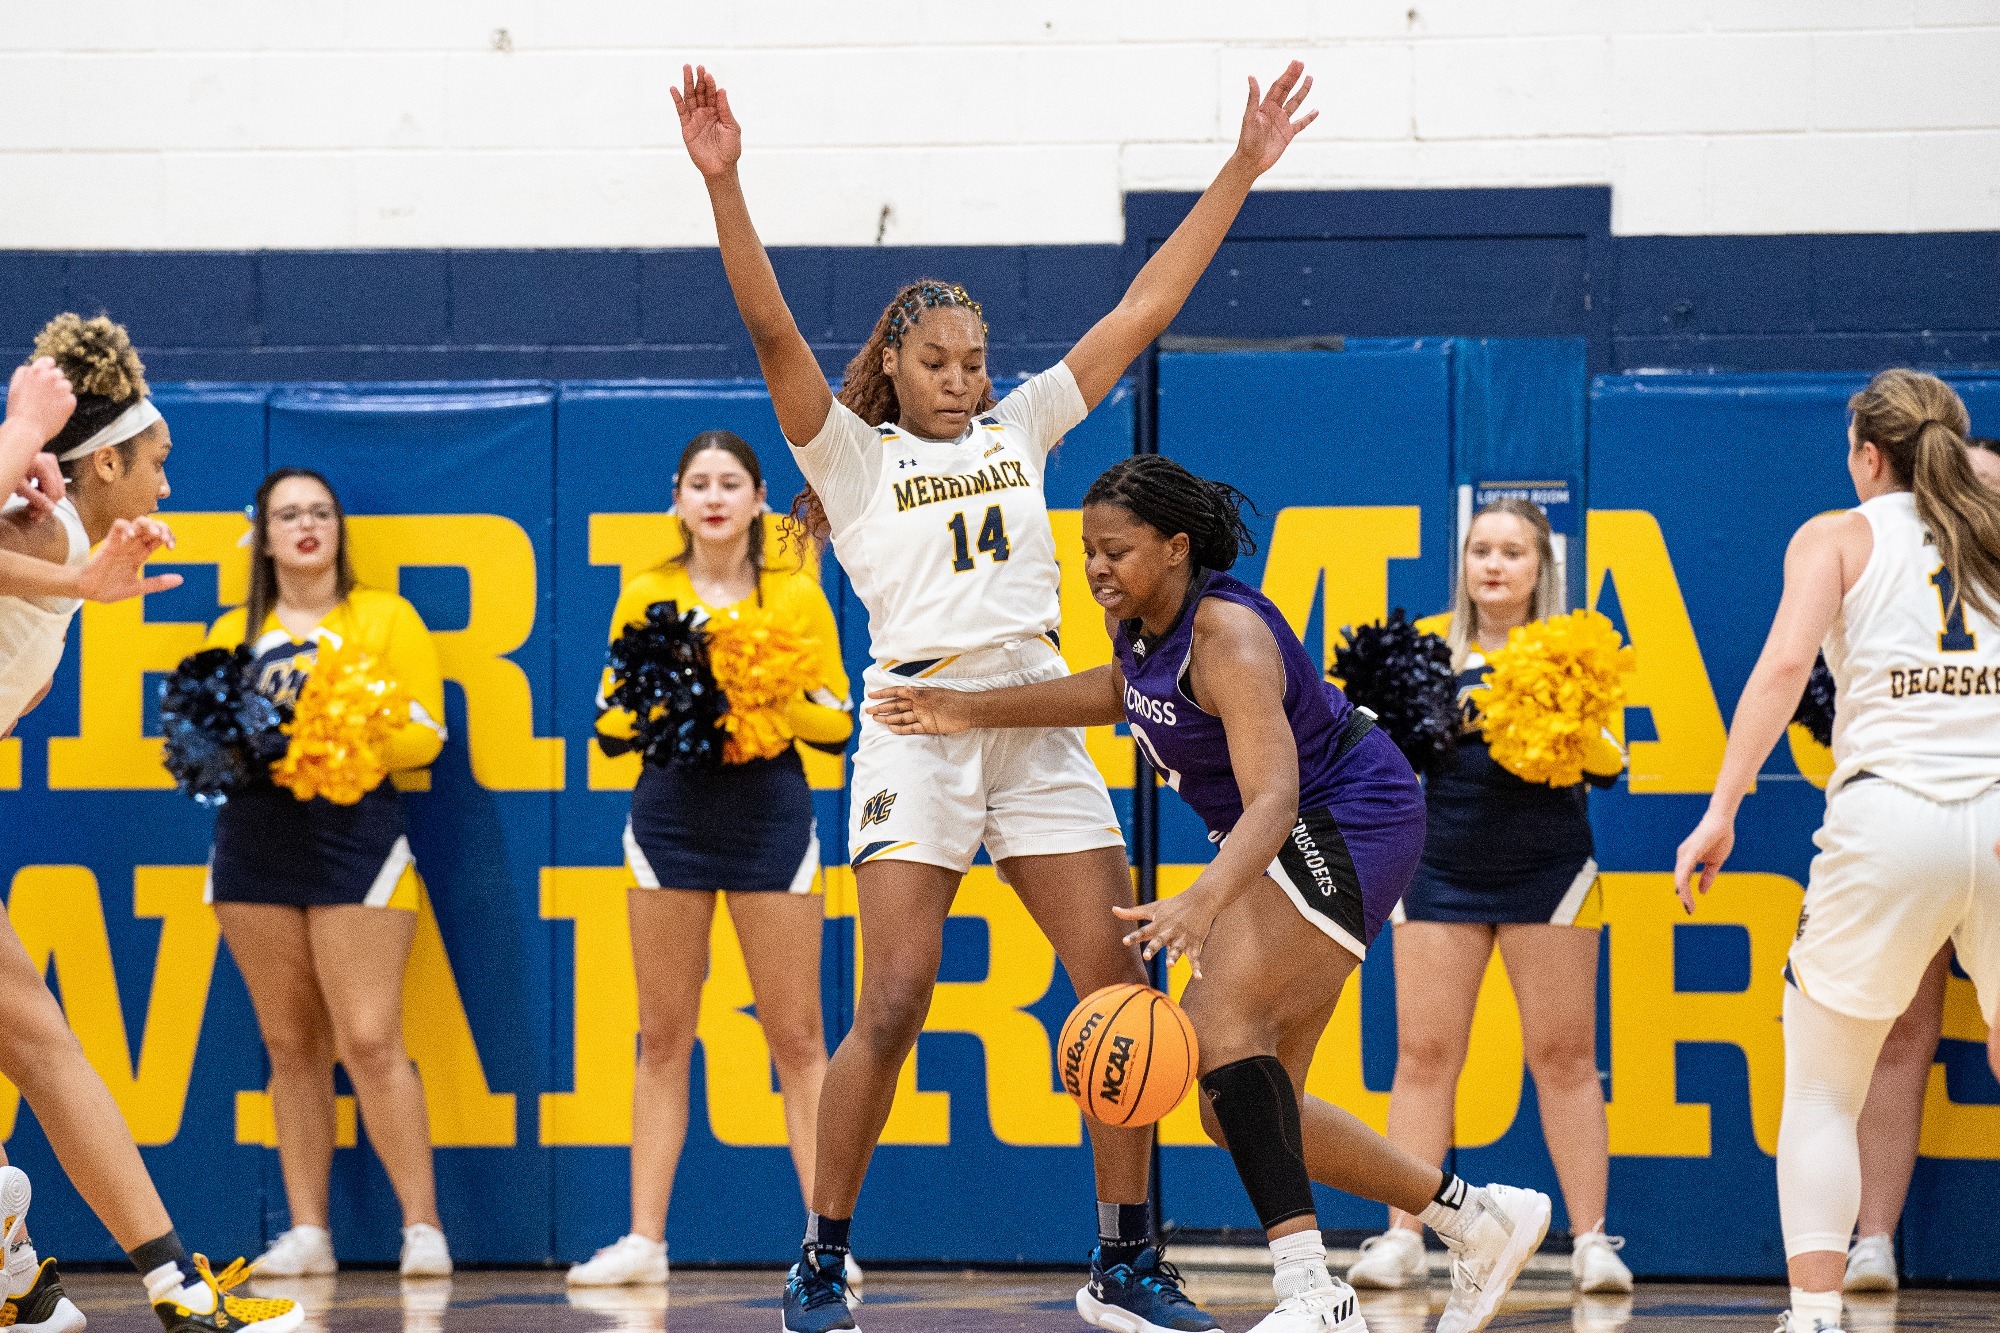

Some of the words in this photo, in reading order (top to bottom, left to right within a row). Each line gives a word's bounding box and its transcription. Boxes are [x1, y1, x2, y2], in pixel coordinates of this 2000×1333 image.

[893, 460, 1031, 512] MERRIMACK
[947, 503, 1011, 574] 14
[1928, 562, 1978, 652] 1
[1126, 685, 1177, 726] CROSS
[1291, 817, 1337, 897] RUSADERS
[1100, 1034, 1135, 1105] NCAA
